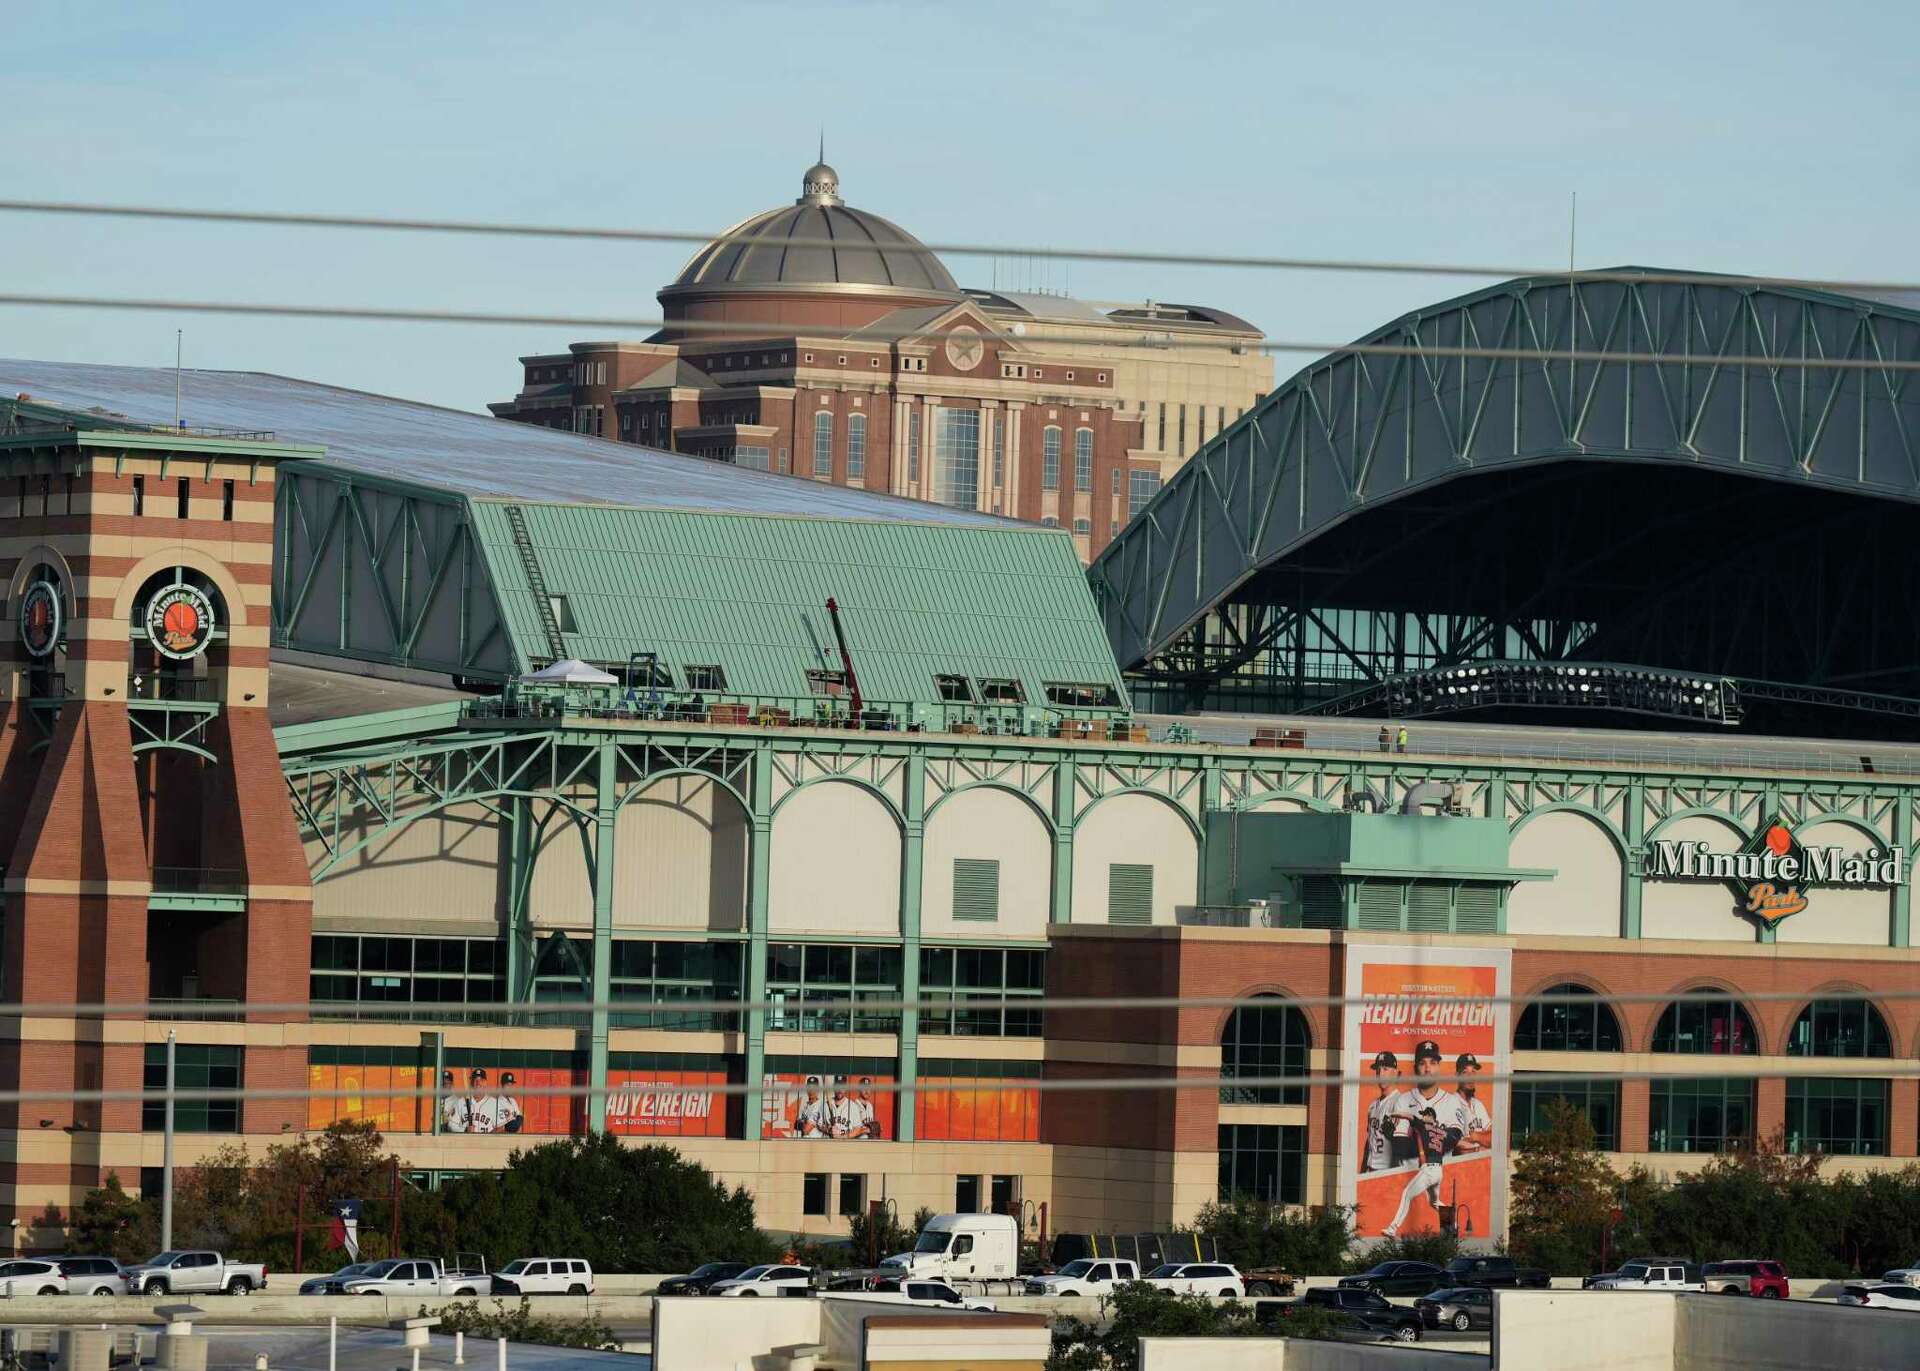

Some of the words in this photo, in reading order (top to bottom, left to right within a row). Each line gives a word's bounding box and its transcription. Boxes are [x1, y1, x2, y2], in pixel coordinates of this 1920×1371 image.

[190, 593, 208, 629] Maid
[1655, 841, 1798, 880] Minute
[1804, 846, 1904, 884] Maid
[1748, 882, 1808, 921] Park
